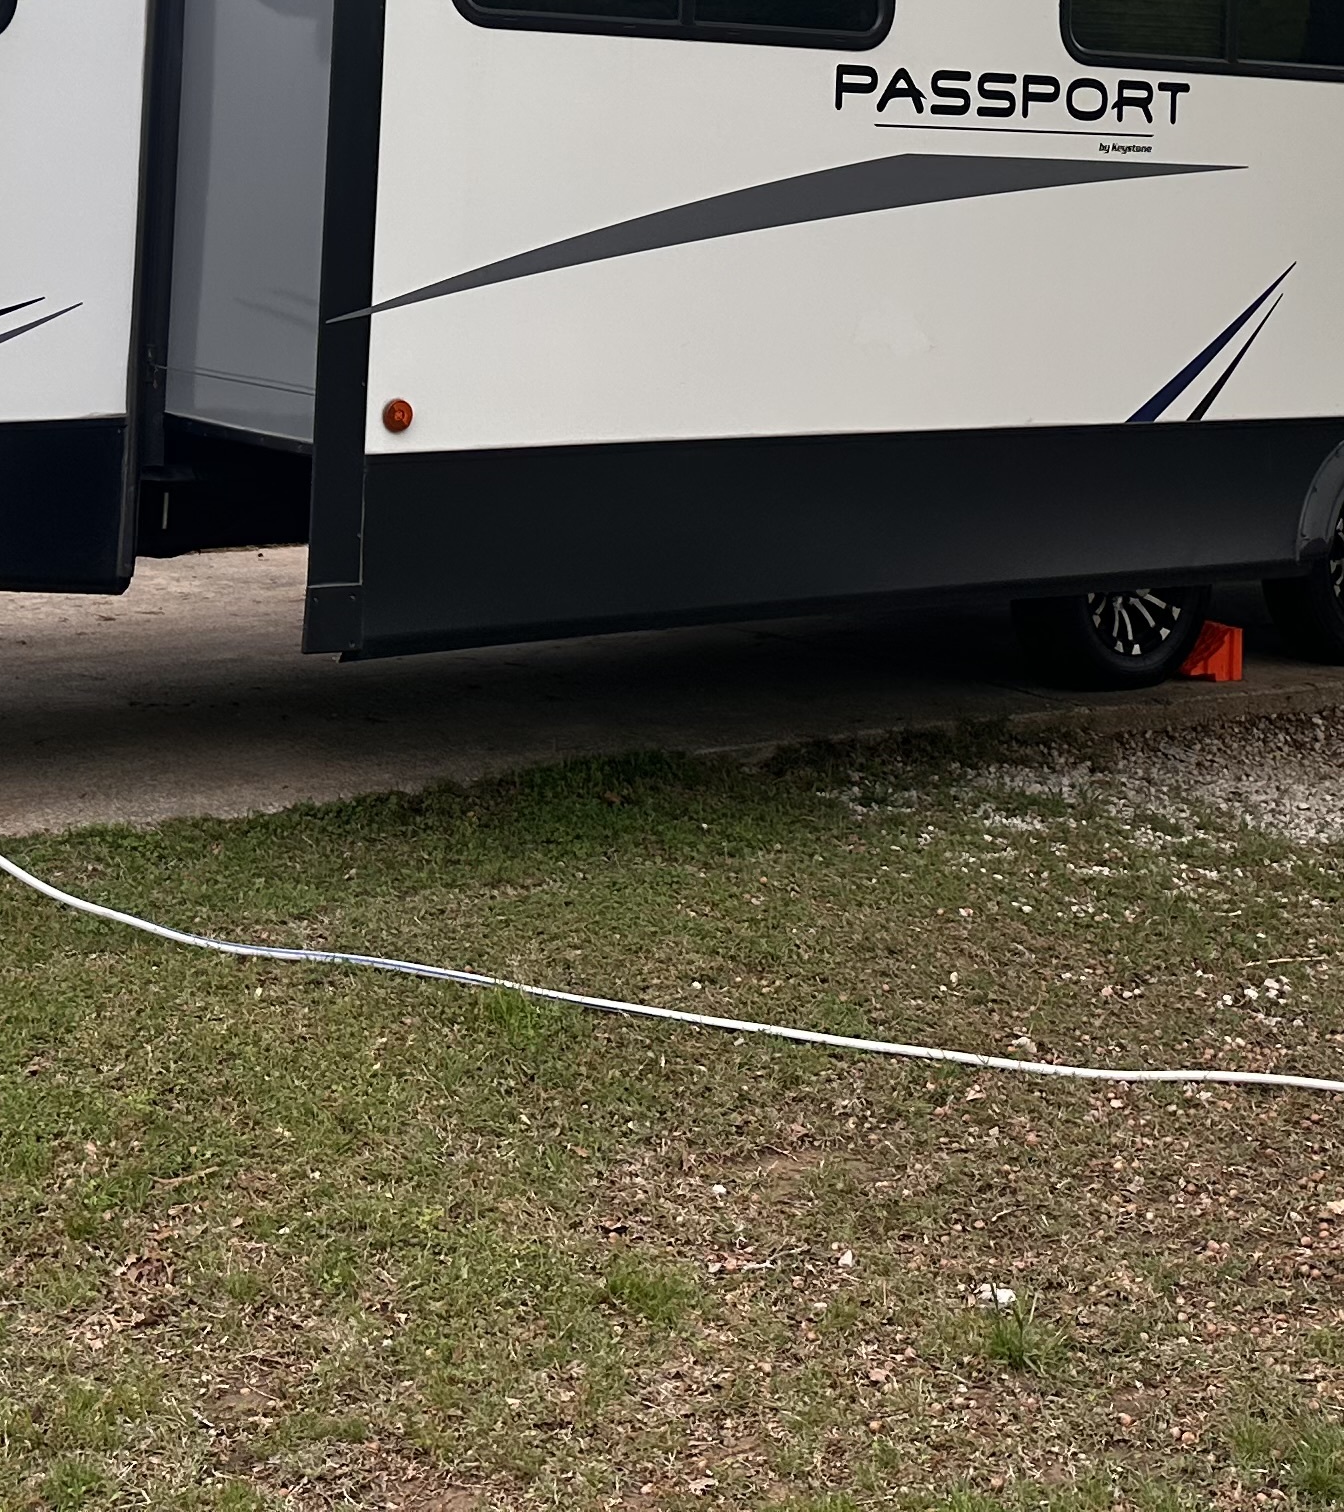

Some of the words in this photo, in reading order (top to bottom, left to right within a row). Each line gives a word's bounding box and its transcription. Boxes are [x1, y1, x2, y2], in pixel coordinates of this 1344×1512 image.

[835, 64, 1191, 125] PASSPORT
[1099, 142, 1110, 154] by
[1111, 142, 1153, 155] Keystone
